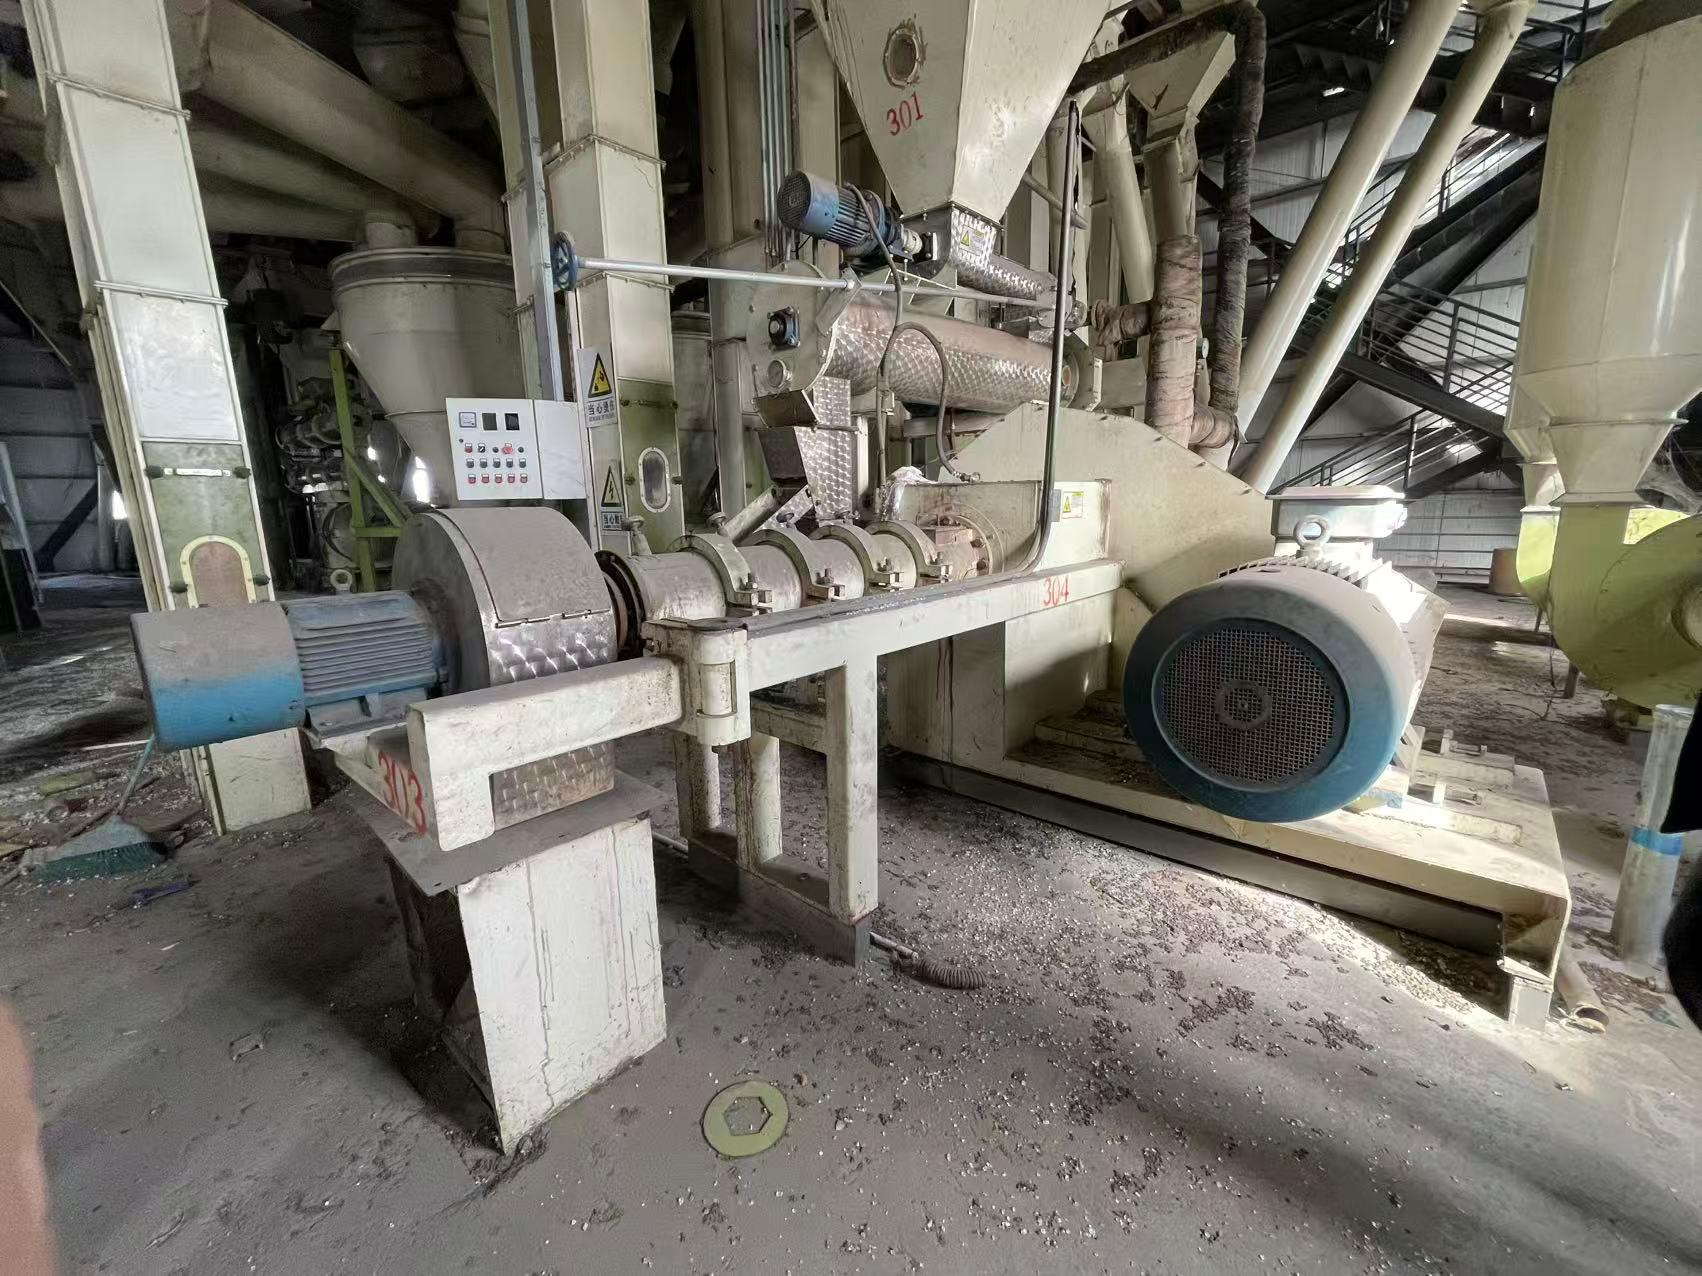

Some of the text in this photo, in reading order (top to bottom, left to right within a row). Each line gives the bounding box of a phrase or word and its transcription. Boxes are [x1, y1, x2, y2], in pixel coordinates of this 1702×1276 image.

[887, 91, 924, 136] 301
[1043, 576, 1070, 606] 304
[378, 751, 428, 838] 303
